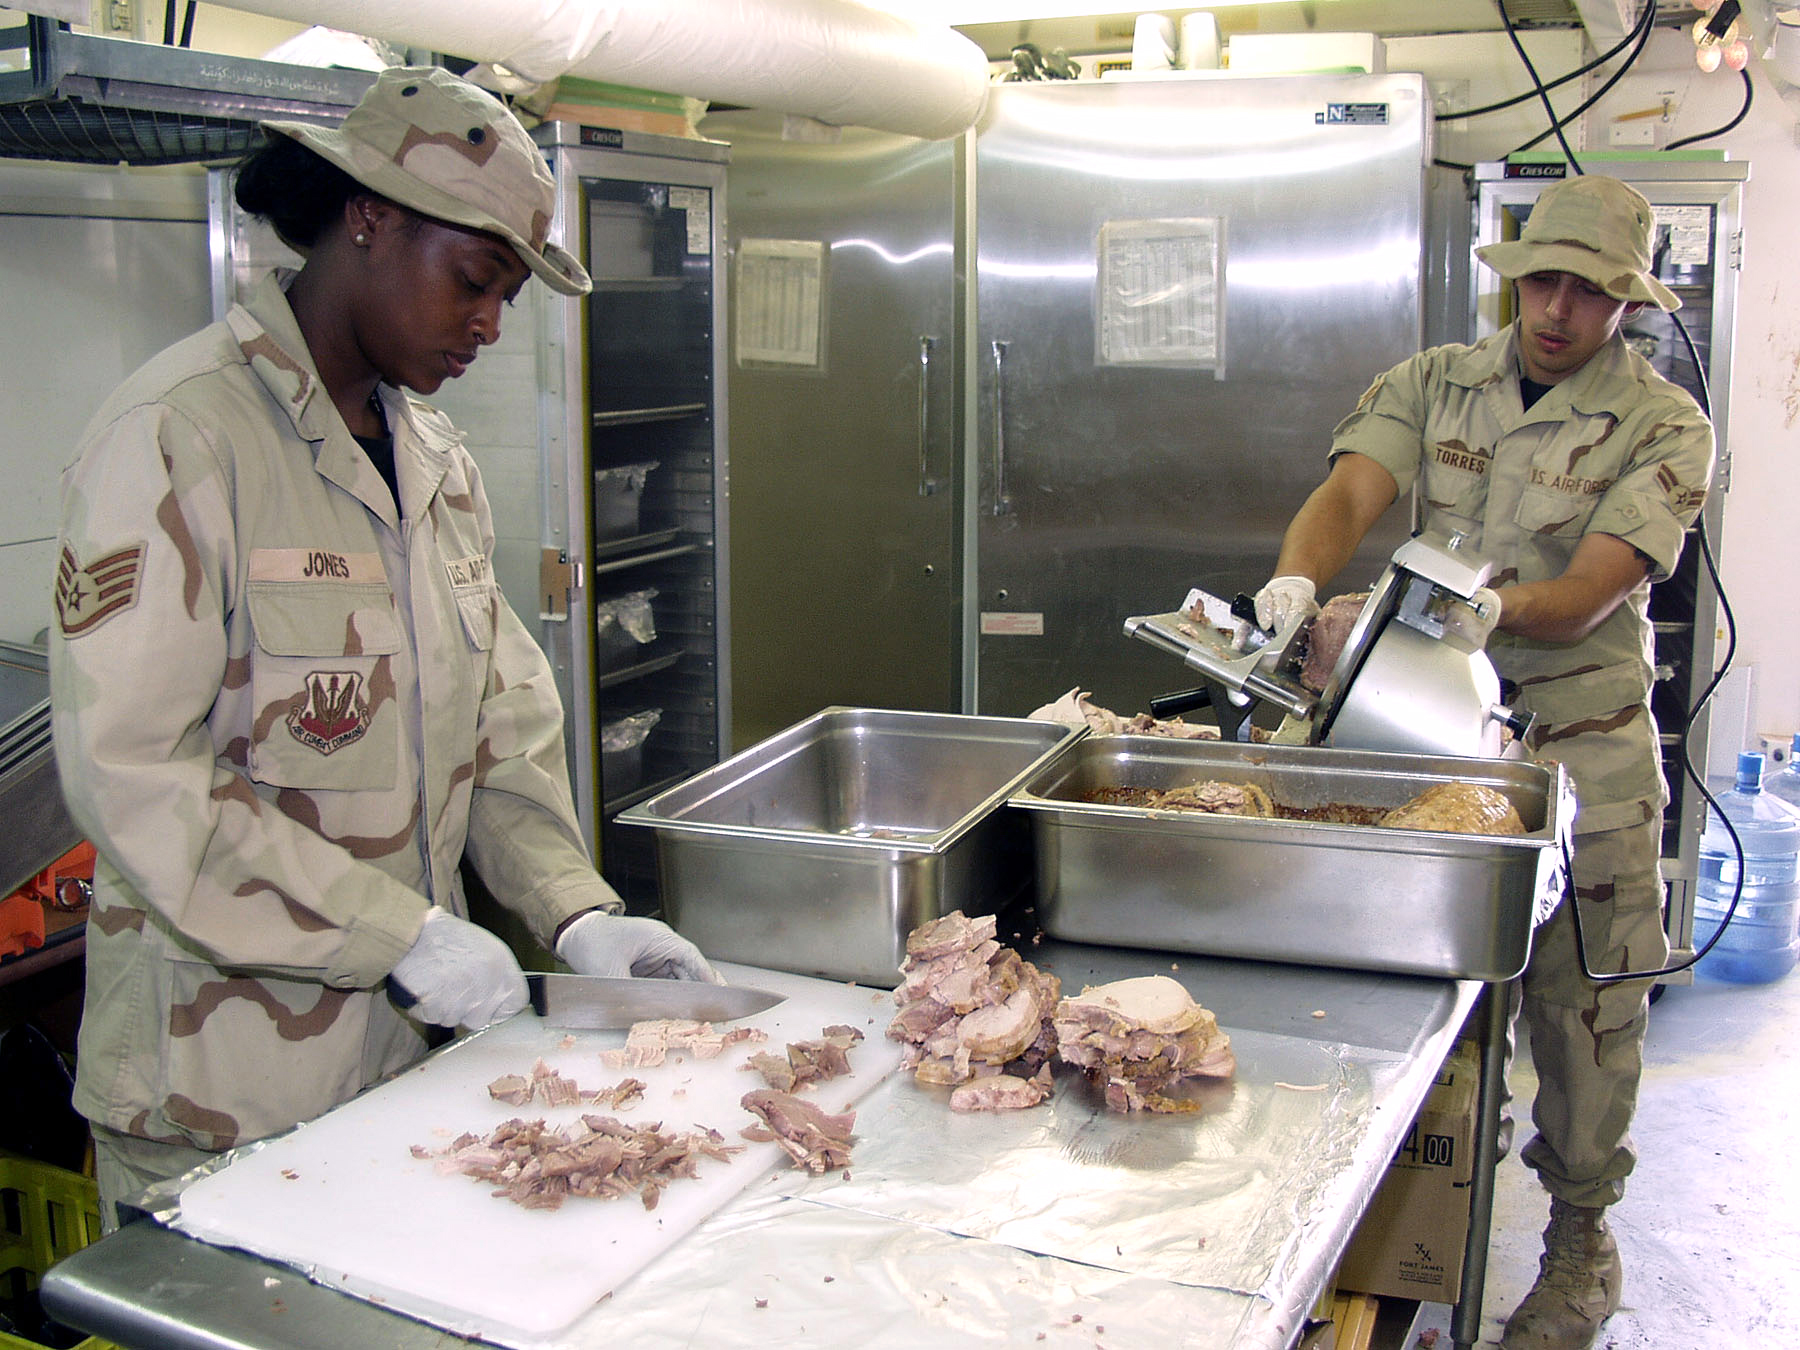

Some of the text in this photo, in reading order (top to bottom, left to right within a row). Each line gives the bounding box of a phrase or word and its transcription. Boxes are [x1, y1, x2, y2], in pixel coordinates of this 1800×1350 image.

[1435, 448, 1485, 475] TORRES
[1550, 475, 1575, 492] AIR
[304, 552, 350, 578] JONES
[331, 724, 365, 749] COMMAND
